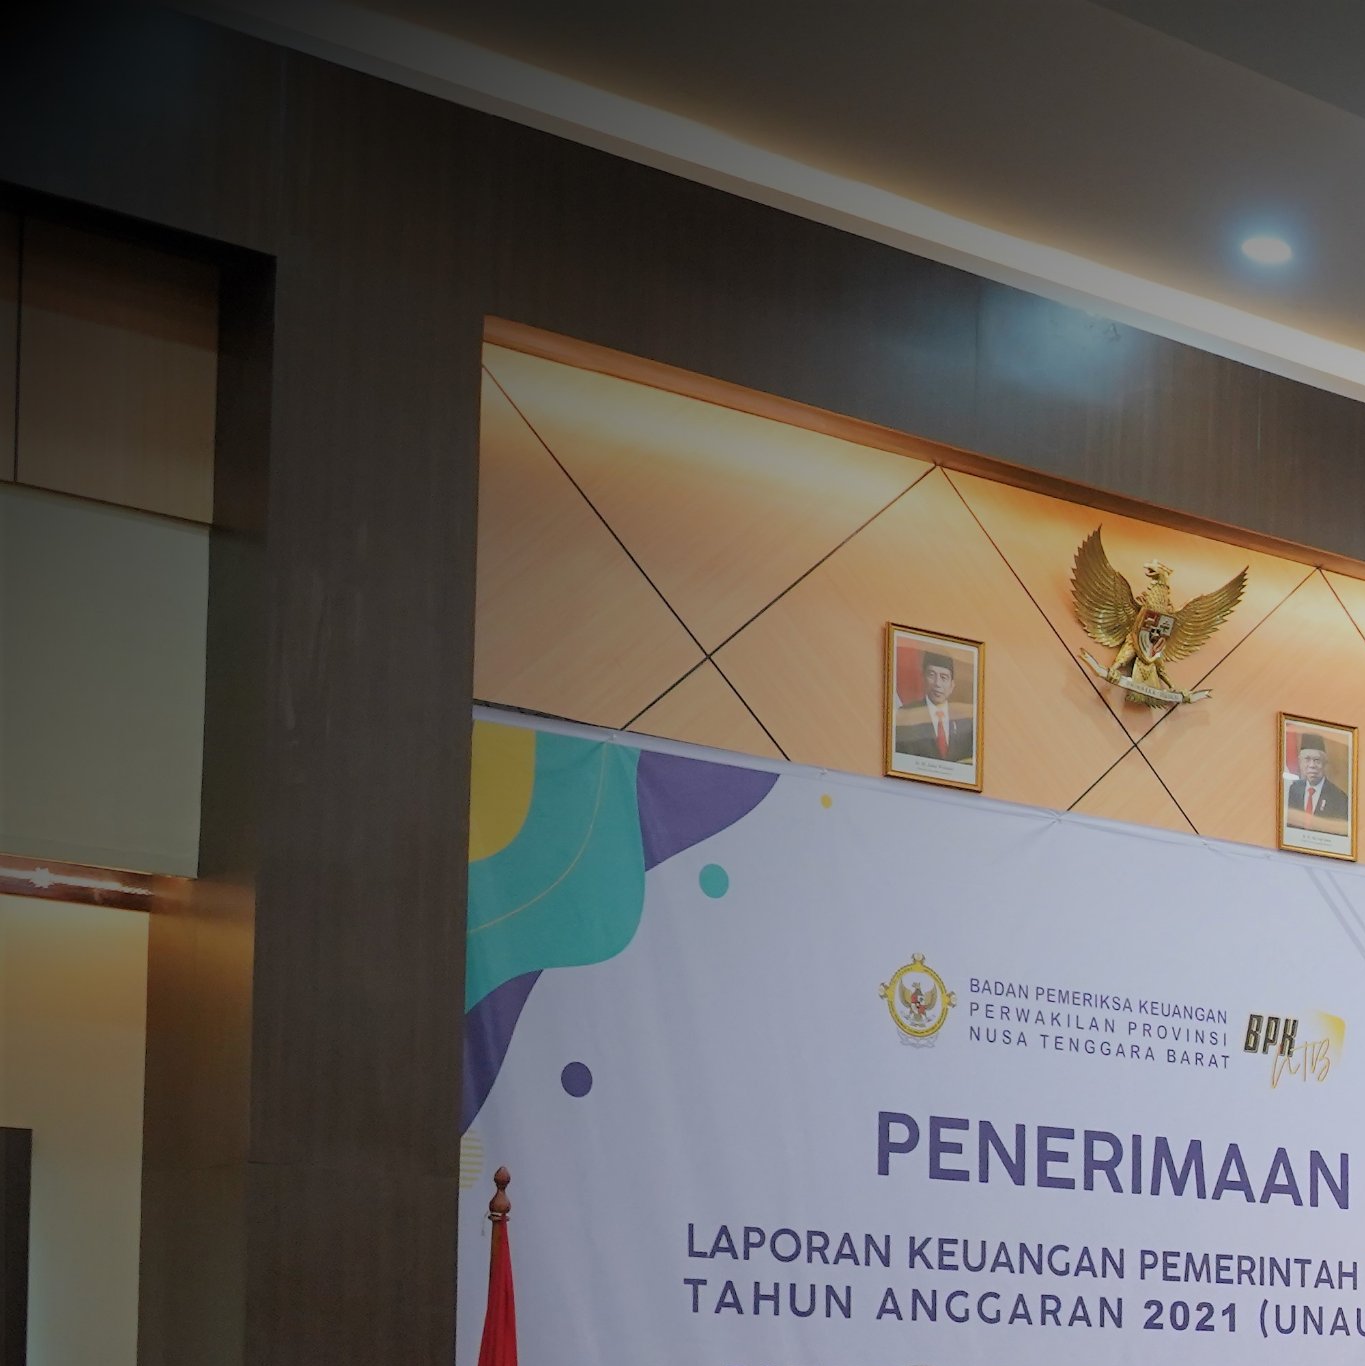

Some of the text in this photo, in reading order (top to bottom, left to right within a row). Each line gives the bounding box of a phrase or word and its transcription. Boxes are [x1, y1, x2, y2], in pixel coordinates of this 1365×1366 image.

[970, 978, 1226, 1024] BADAN PEMERIKSA KEUANGAN
[970, 1002, 1226, 1046] PERWAKILAN PROVINSI
[970, 1026, 1229, 1068] NUSA TENGGARA BARAT
[1244, 1014, 1299, 1057] BPK
[878, 1111, 1349, 1209] PENERIMAAN
[688, 1223, 890, 1267] LAPORAN
[909, 1236, 1124, 1279] KEUANGAN
[1140, 1250, 1357, 1290] PEMERINTAH
[684, 1278, 851, 1318] TAHUN
[876, 1288, 1122, 1328] ANGGARAN
[1143, 1300, 1235, 1332] 2021
